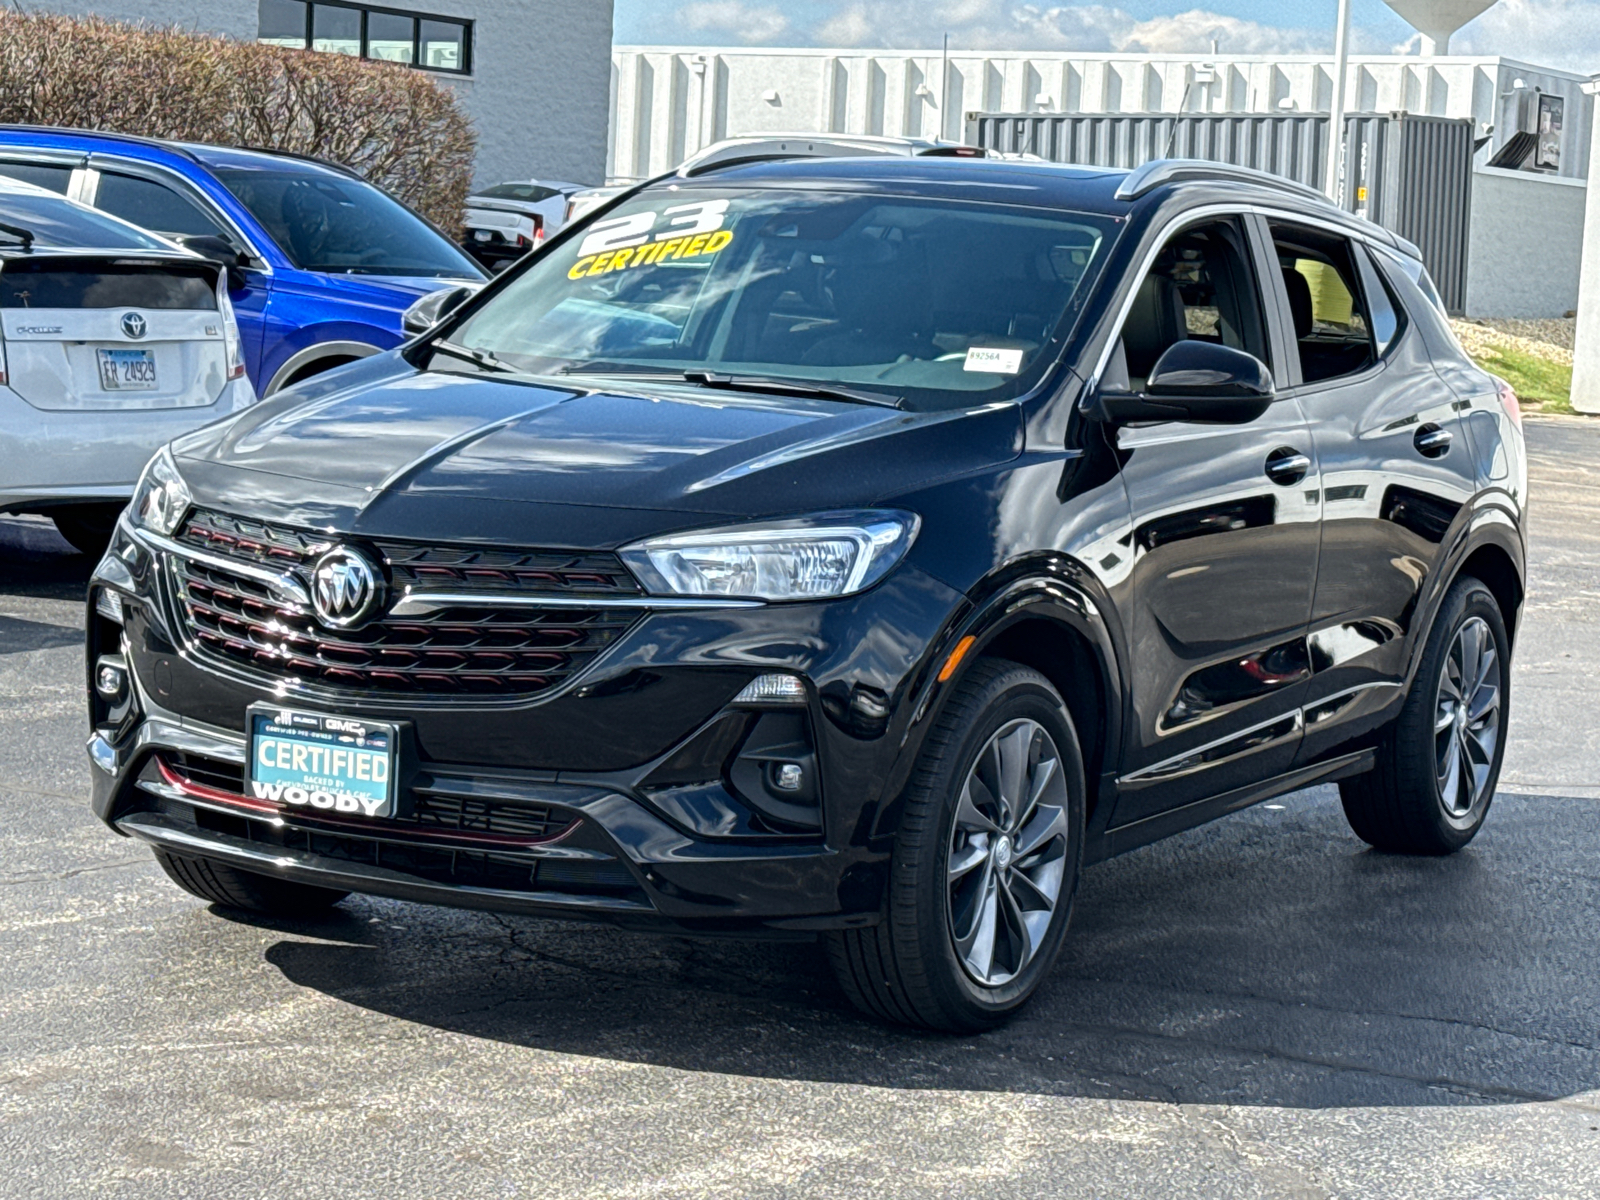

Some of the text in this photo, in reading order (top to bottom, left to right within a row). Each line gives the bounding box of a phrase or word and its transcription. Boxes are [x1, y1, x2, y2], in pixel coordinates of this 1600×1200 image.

[577, 199, 731, 257] 23
[567, 230, 734, 280] CERTIFIED
[103, 360, 156, 382] FR 24929
[325, 719, 361, 733] GMC
[258, 740, 388, 782] CERTIFIED
[251, 781, 386, 816] WOODY
[303, 775, 346, 788] BACKED BY
